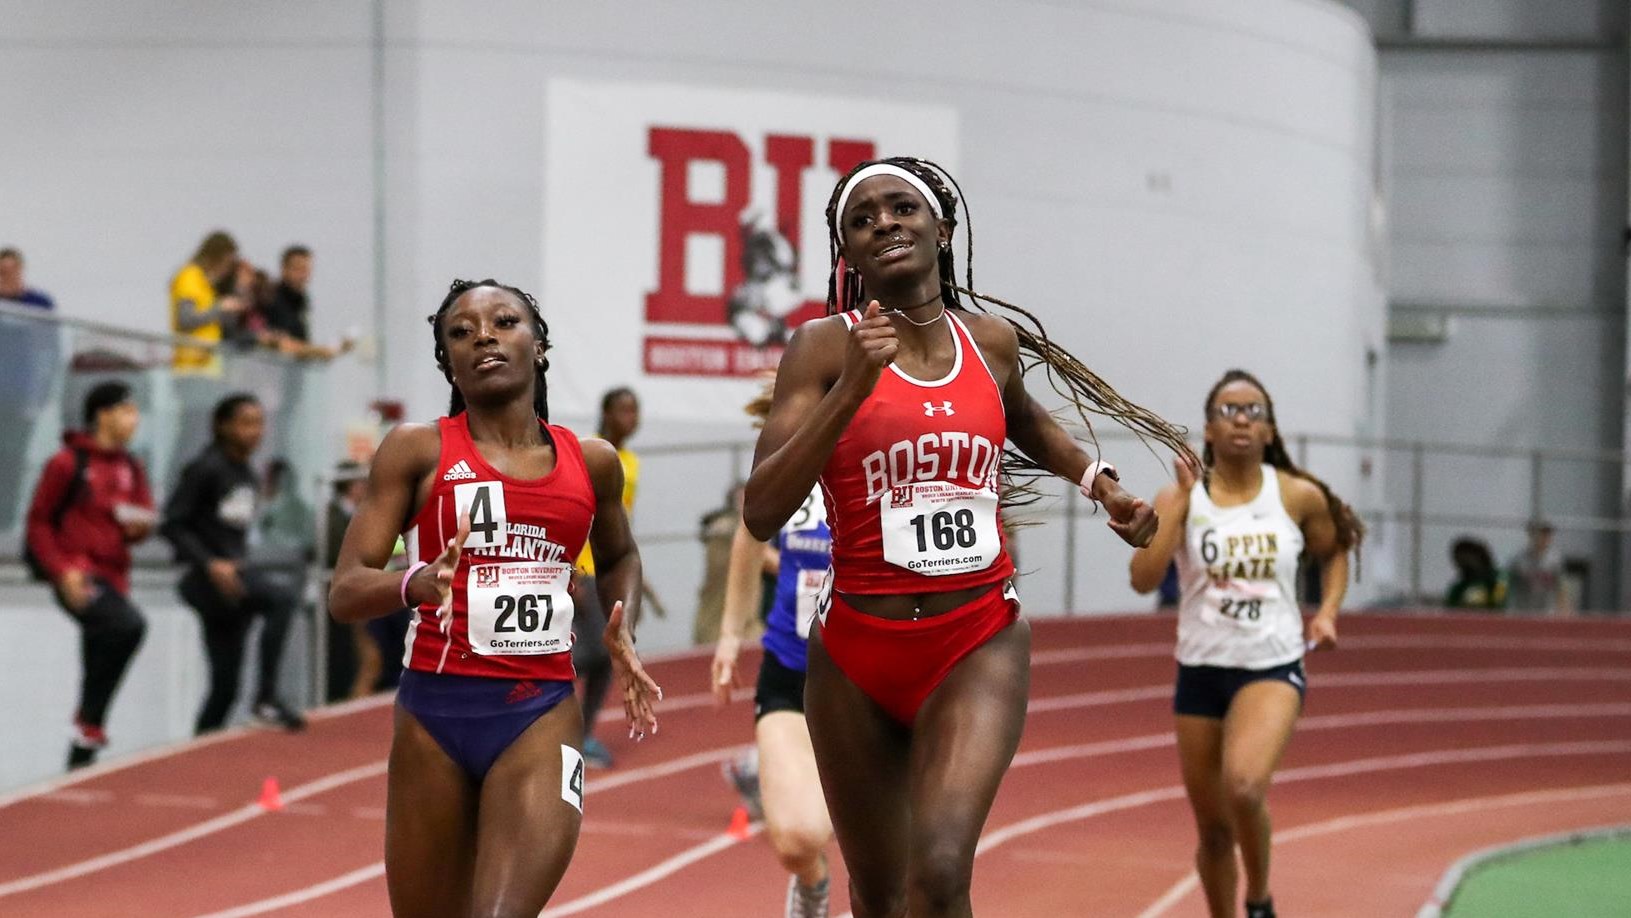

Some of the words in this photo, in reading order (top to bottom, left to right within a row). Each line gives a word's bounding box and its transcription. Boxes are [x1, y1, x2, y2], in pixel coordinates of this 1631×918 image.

[645, 125, 876, 326] BU
[443, 471, 477, 482] adidas
[862, 431, 1000, 506] BOSTON
[890, 485, 914, 504] BU
[915, 485, 943, 493] BOSTON
[469, 486, 498, 544] 4
[505, 523, 547, 539] LORIDA
[909, 508, 977, 552] 168
[1201, 527, 1218, 563] 6
[1226, 533, 1278, 557] PPIN
[907, 555, 983, 569] GoTerriers.com
[477, 566, 500, 583] BU
[494, 594, 554, 633] 267
[490, 638, 560, 648] GoTerriers.com
[570, 757, 583, 808] 4
